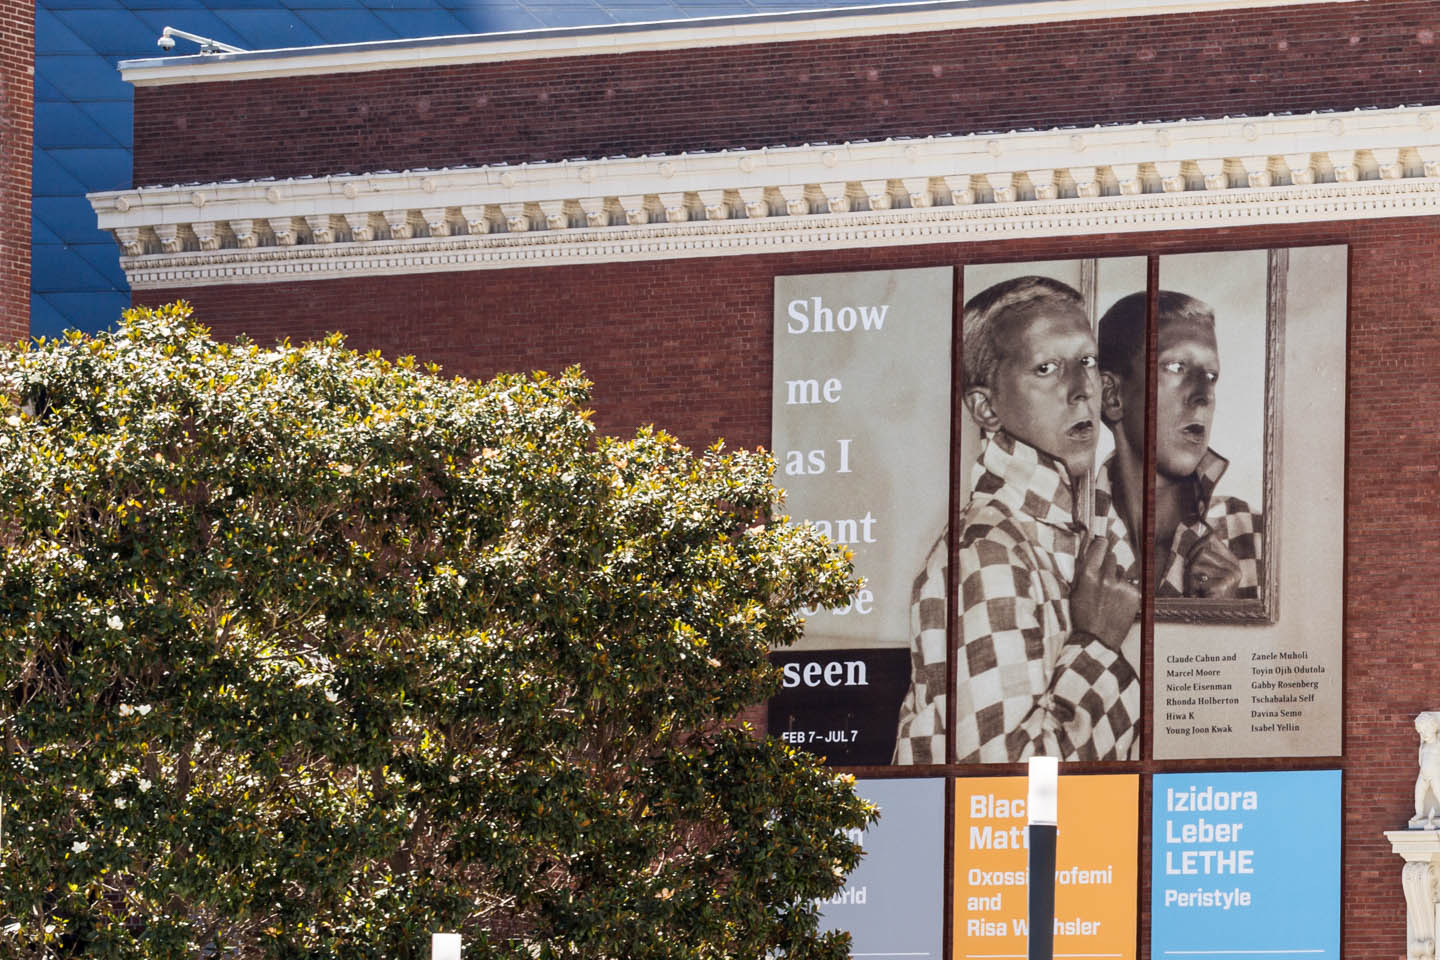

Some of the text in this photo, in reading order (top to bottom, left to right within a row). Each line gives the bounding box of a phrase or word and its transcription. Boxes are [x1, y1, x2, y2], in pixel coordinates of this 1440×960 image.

[787, 296, 890, 334] Show
[785, 377, 842, 405] me
[785, 439, 853, 476] as I
[786, 511, 878, 545] ant
[1167, 653, 1237, 664] Claude Cahun and
[1251, 651, 1308, 661] Zanele Muholi
[782, 660, 869, 688] seen
[1166, 669, 1221, 678] Marcel Moore
[1252, 665, 1326, 676] Toyin Ojih Odutola
[1166, 683, 1232, 692] Nicole Eisenman
[1251, 680, 1319, 691] Gabby Rosenberg
[1166, 697, 1240, 706] Rhonda Holberton
[1252, 694, 1315, 704] Tschabalala Self
[1166, 712, 1195, 721] Hiwa K
[1251, 709, 1302, 718] Davina Semo
[1166, 724, 1233, 737] Young Joon Kwak
[1251, 723, 1300, 733] Isabel Yellin
[782, 731, 805, 743] FEB
[850, 730, 858, 742] 7
[969, 793, 1029, 819] Blac
[1167, 785, 1258, 812] Izidora
[1166, 818, 1243, 844] Leber
[1166, 850, 1255, 875] LETHE
[968, 867, 1029, 886] Oxossi
[967, 893, 1002, 911] and
[1164, 887, 1252, 911] Peristyle
[967, 917, 1102, 937] Risa Whsler
